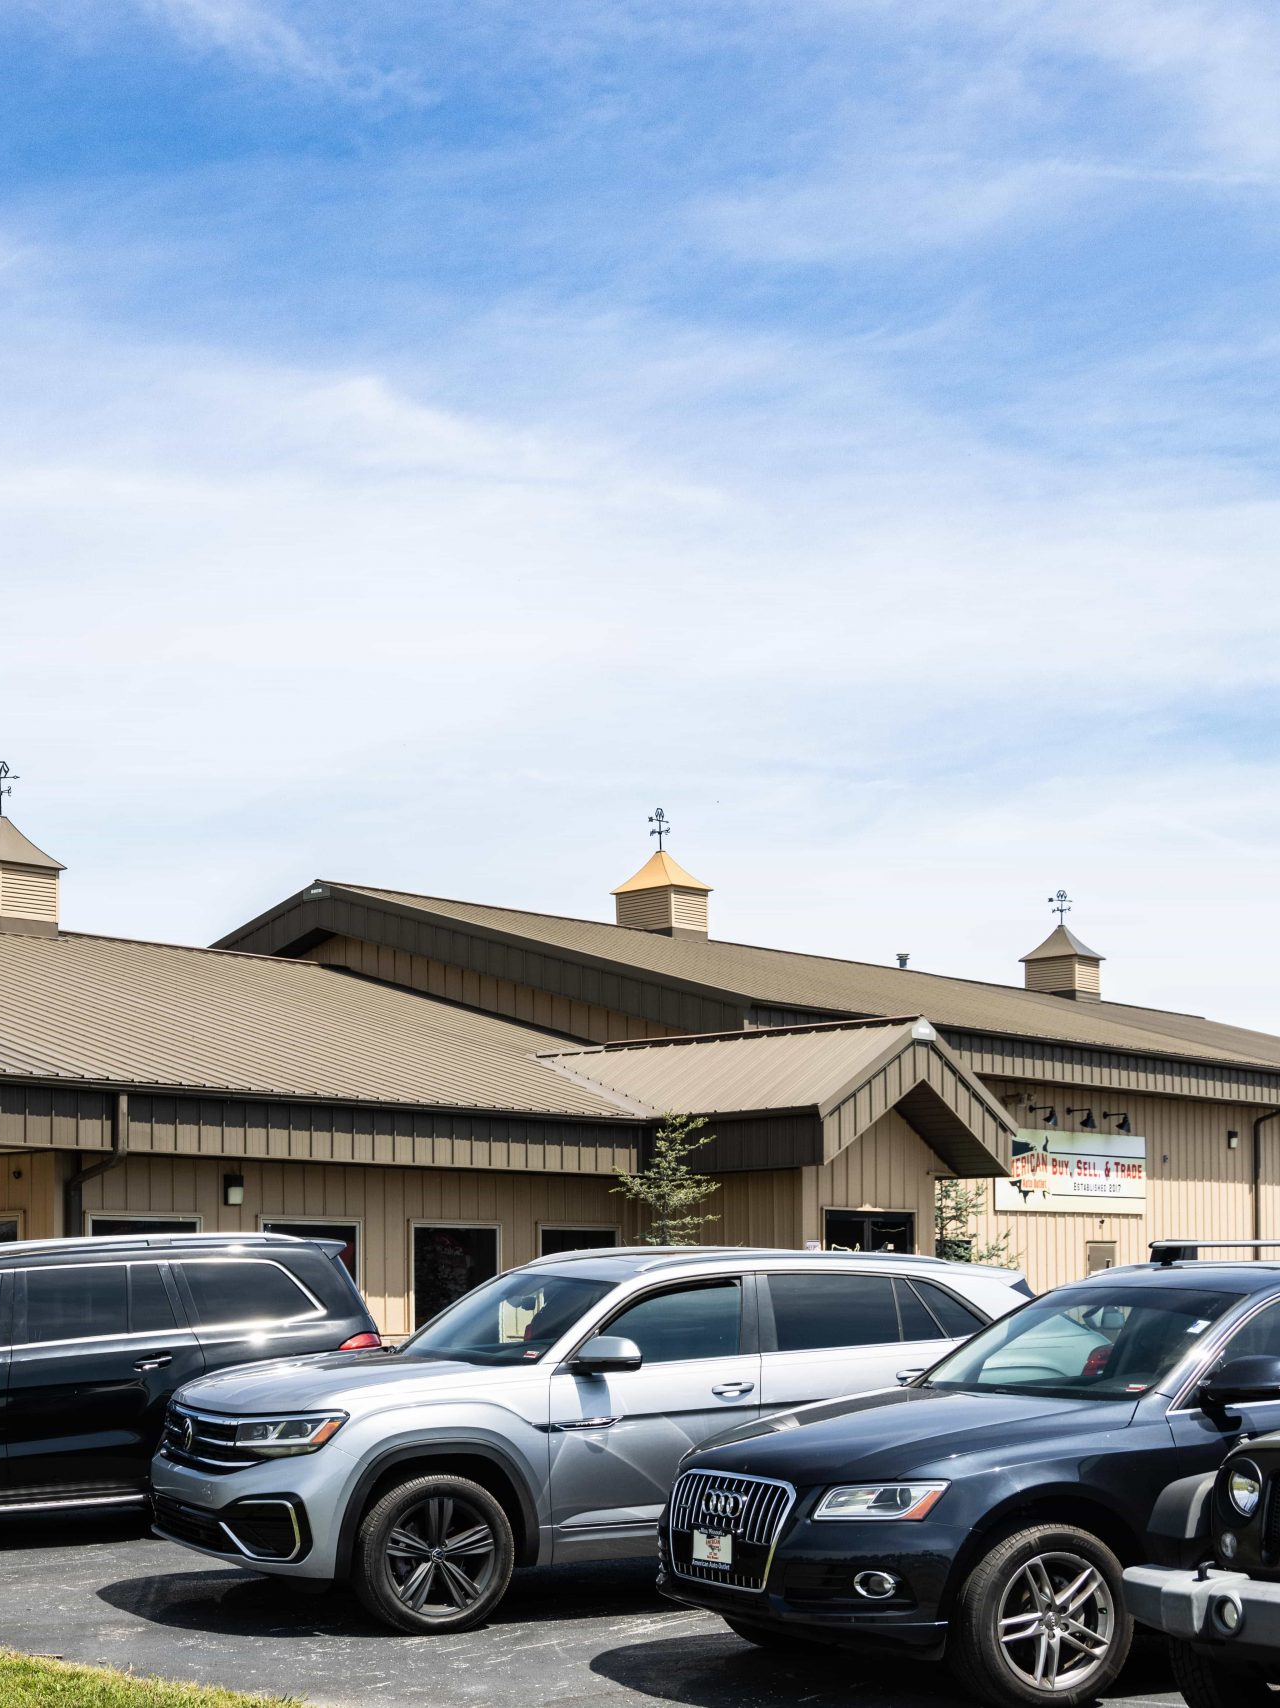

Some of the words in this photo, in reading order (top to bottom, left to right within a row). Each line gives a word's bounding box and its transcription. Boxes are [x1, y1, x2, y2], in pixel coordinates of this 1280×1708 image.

[1011, 1153, 1047, 1178] ERICAN
[1051, 1158, 1073, 1178] BUY,
[1104, 1161, 1111, 1178] &
[1114, 1162, 1142, 1179] TRADE
[1073, 1182, 1107, 1192] ESTABLISHED
[1109, 1184, 1122, 1193] 2017
